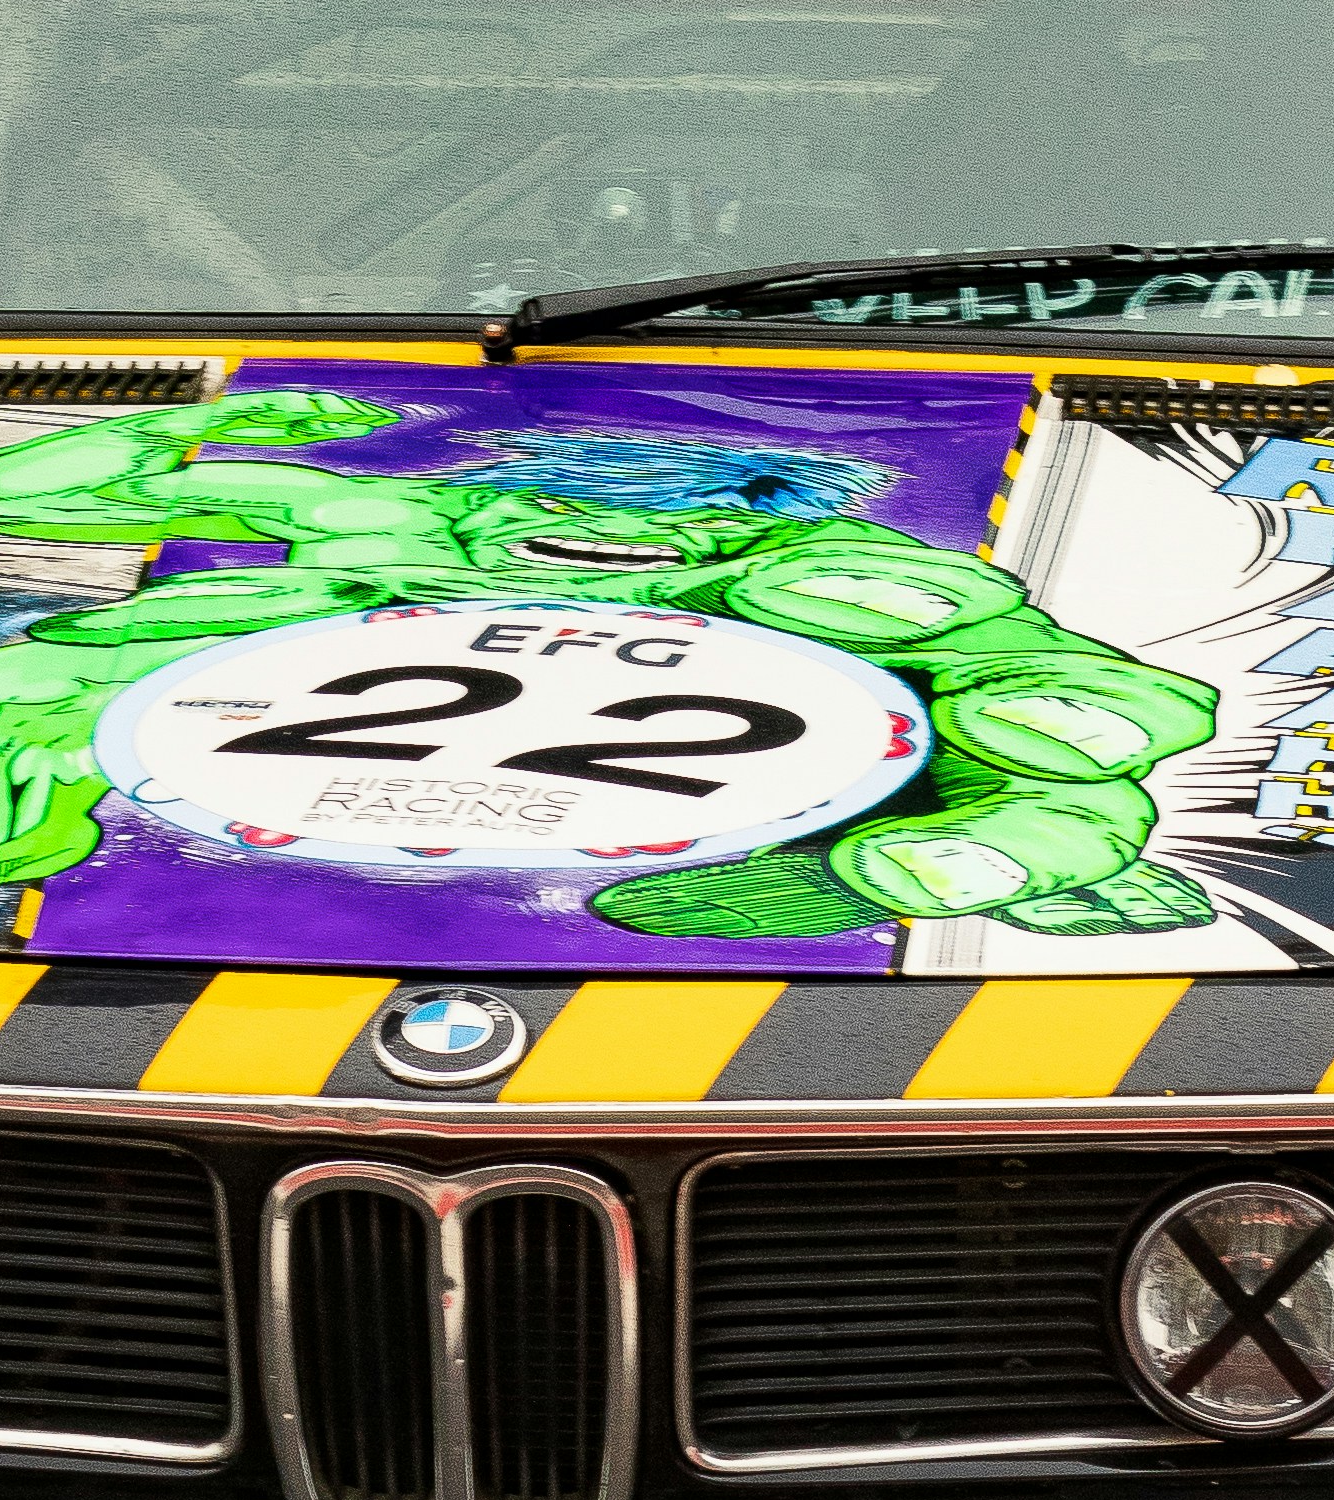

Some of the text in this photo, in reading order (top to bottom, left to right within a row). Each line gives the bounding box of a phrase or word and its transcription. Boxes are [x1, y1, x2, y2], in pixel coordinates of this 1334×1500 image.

[469, 622, 695, 668] EFG
[213, 664, 808, 799] 22
[308, 791, 569, 823] RACING
[325, 777, 584, 805] HISTORIC
[299, 812, 557, 836] BY PETER AUTO
